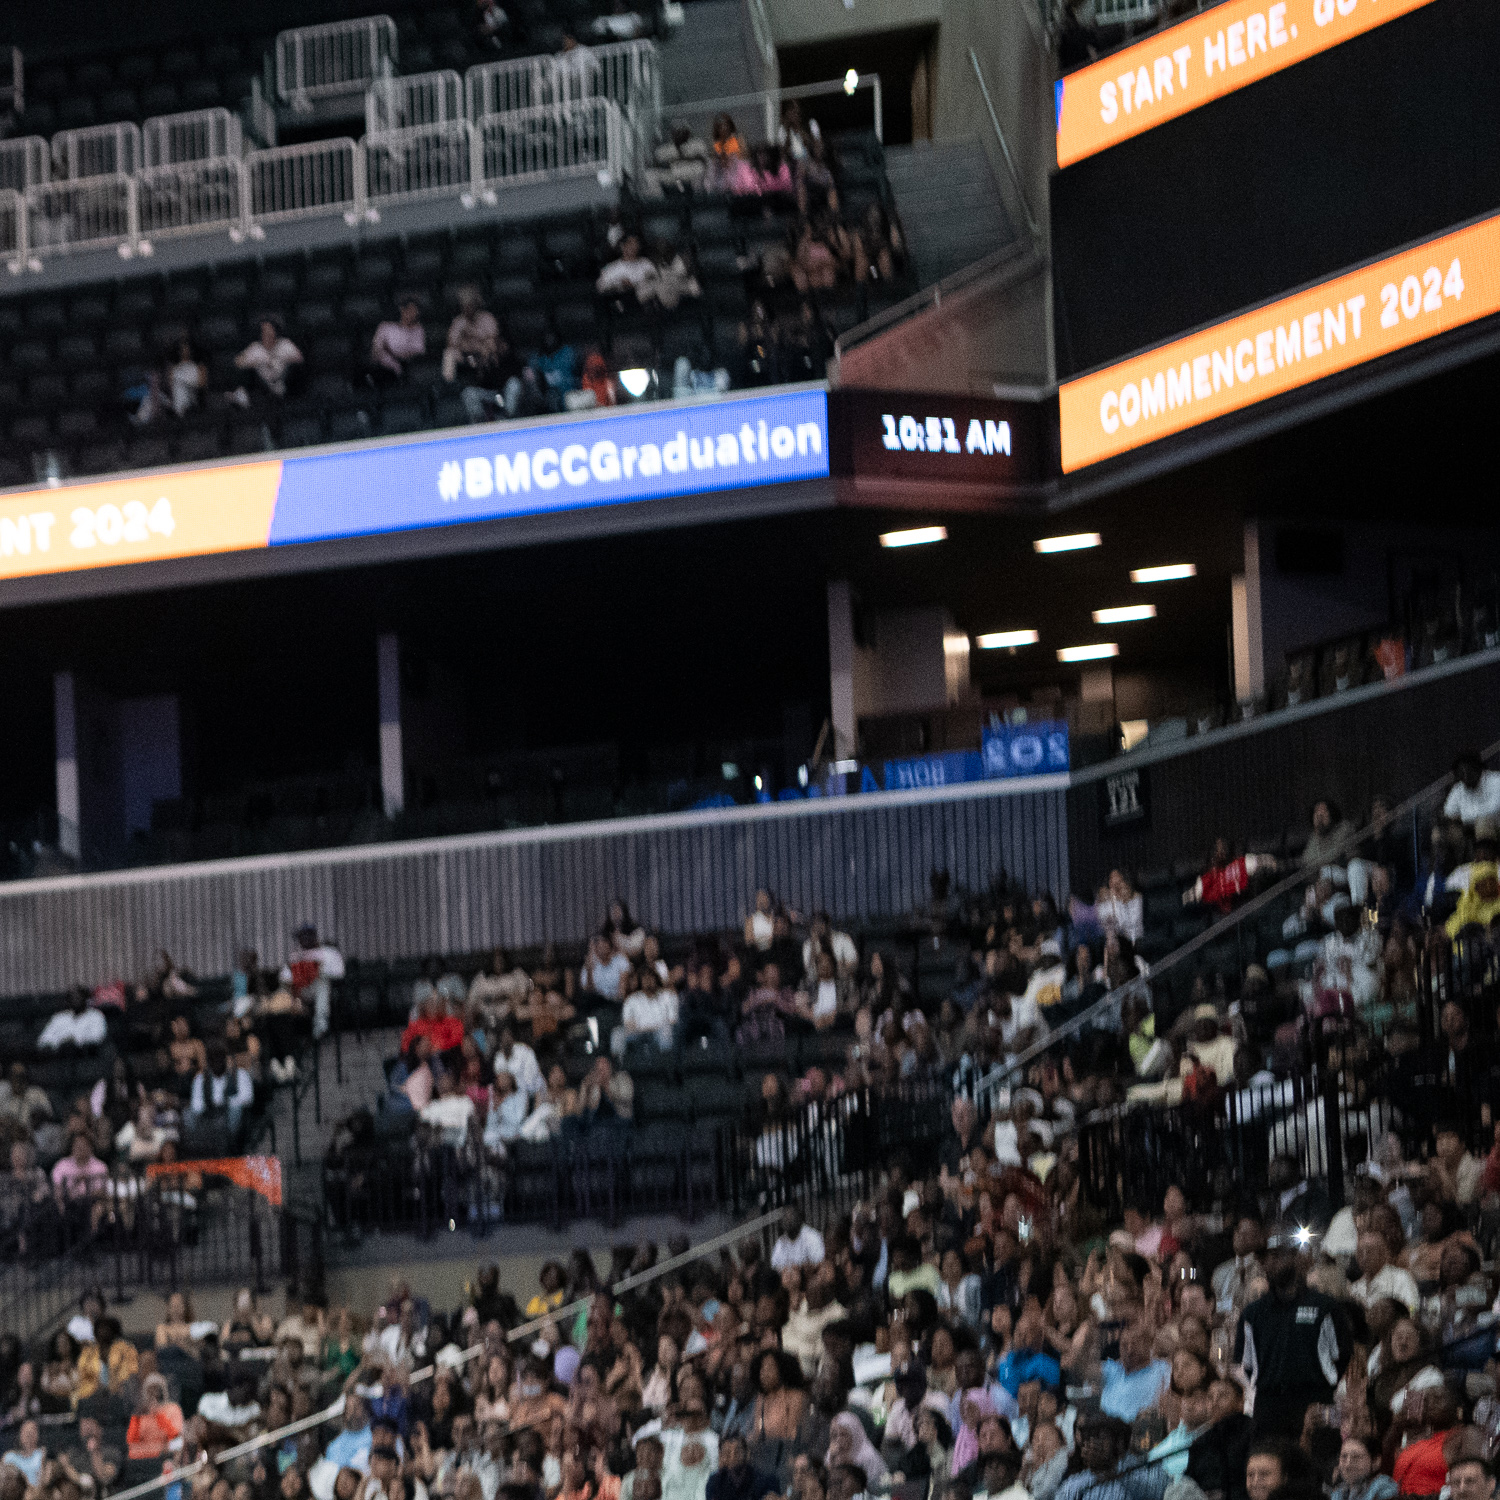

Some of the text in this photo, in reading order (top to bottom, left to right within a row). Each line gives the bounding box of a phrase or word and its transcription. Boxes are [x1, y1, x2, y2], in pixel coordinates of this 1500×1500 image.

[1098, 44, 1192, 125] START
[1099, 257, 1465, 436] COMMENCEMENT 2024
[436, 419, 822, 502] #BMCCGraduation
[965, 418, 1012, 457] AM
[69, 496, 177, 549] 2024
